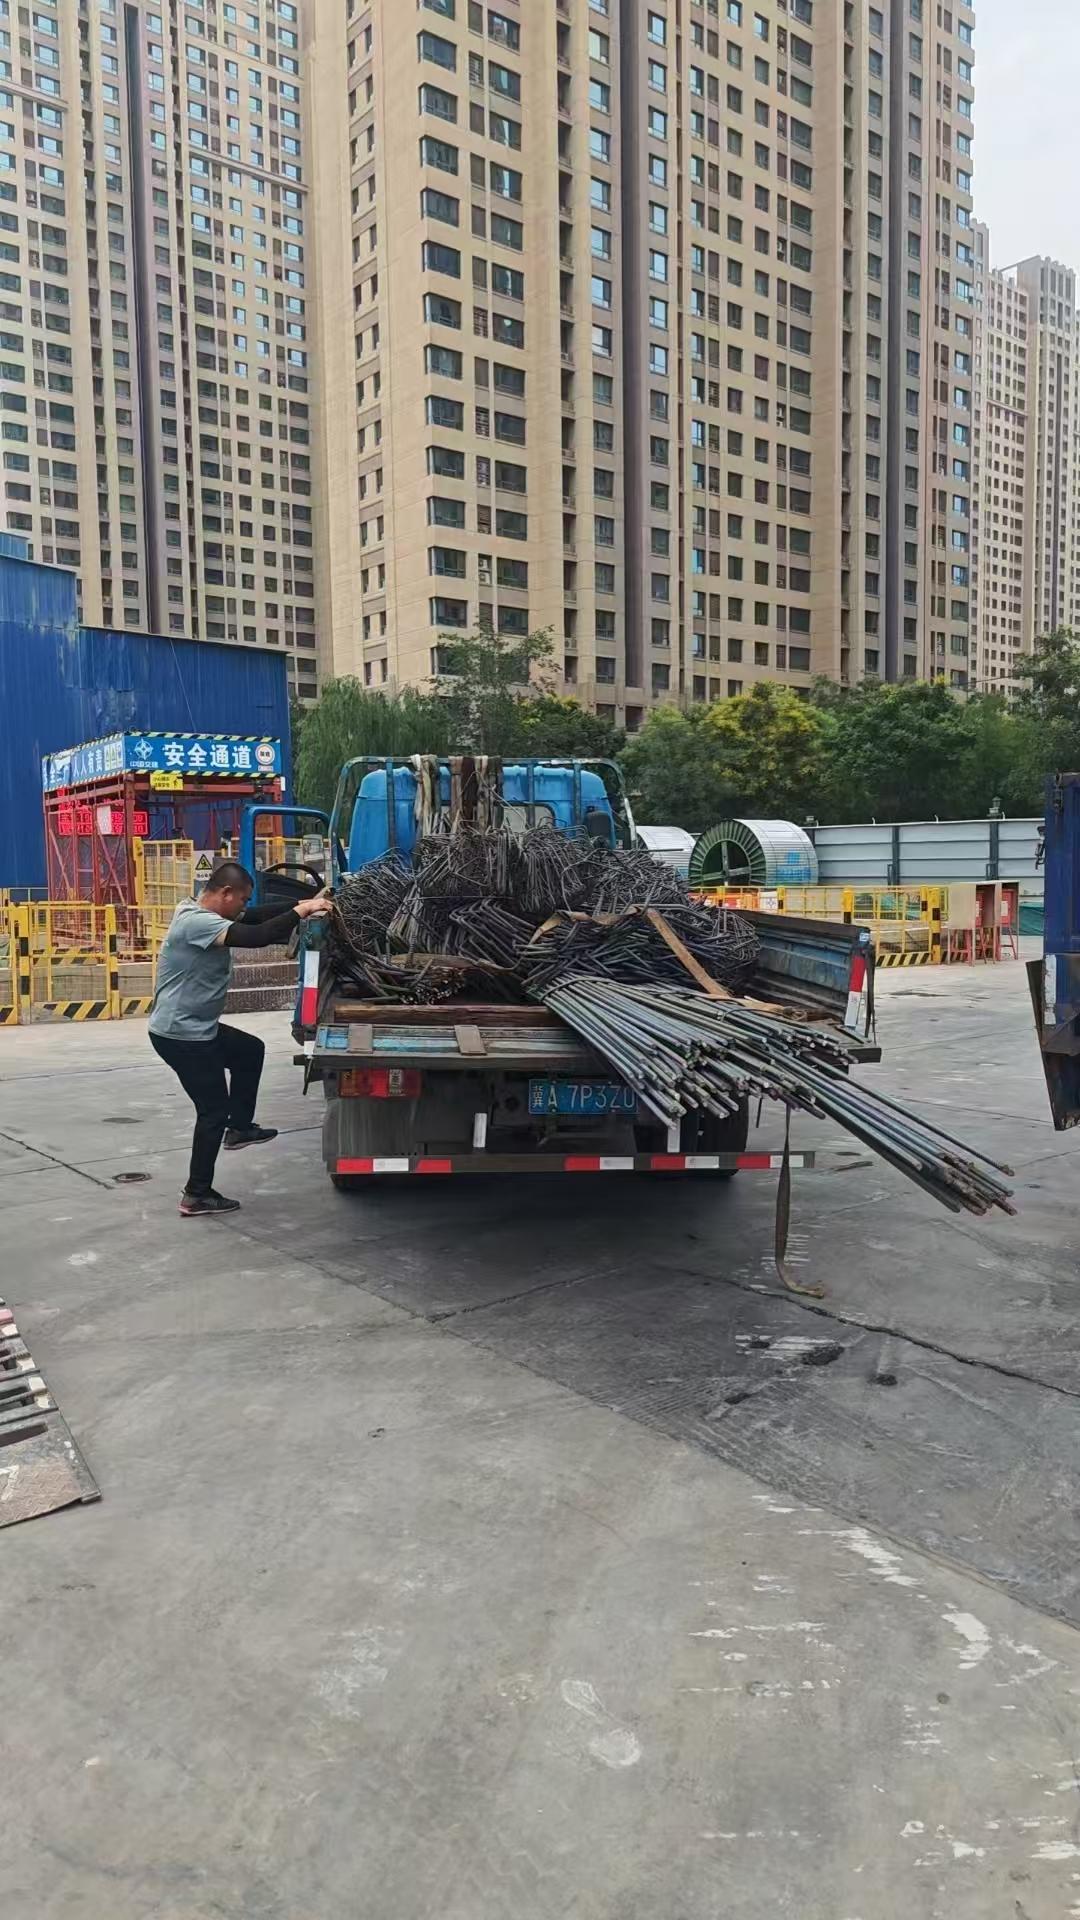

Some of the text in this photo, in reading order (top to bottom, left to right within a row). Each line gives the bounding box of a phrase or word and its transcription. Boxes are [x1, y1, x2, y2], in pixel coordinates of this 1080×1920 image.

[73, 748, 103, 778] 人人有责
[164, 741, 252, 769] 安全通道
